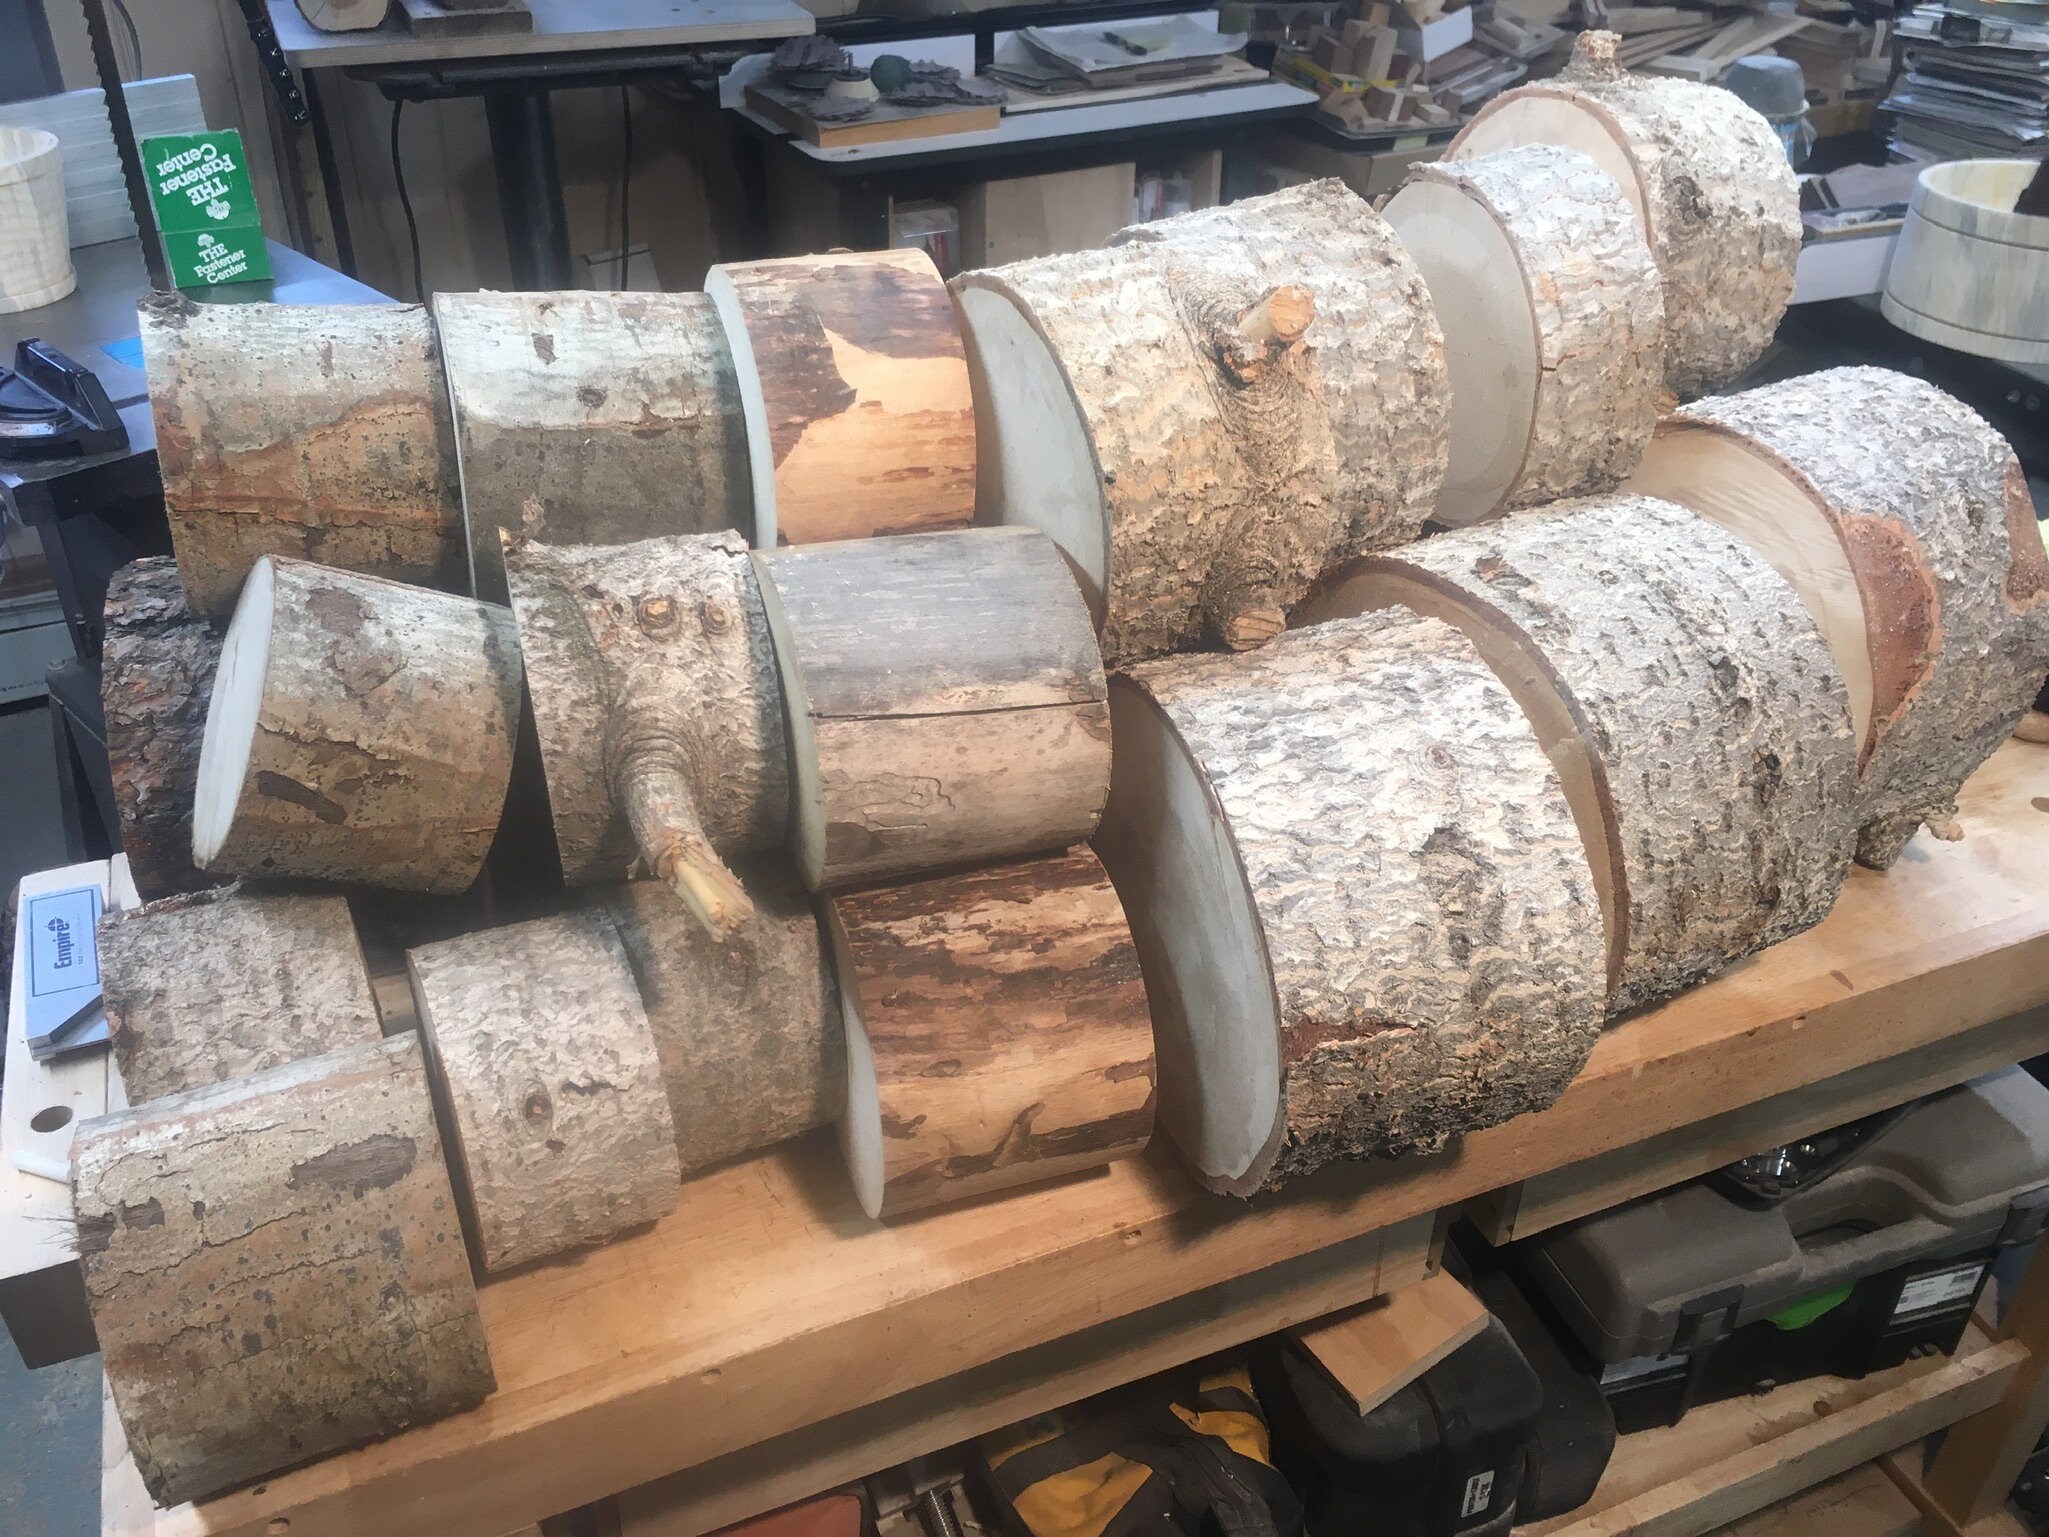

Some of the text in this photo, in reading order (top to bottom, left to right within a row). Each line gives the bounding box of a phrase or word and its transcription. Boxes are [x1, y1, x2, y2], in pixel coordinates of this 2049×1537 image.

[156, 143, 218, 177] Center
[160, 153, 237, 196] Fastener
[185, 177, 229, 206] THE
[194, 249, 246, 278] Fastener
[199, 243, 228, 263] THE
[207, 262, 248, 284] Center
[52, 922, 75, 969] Empire
